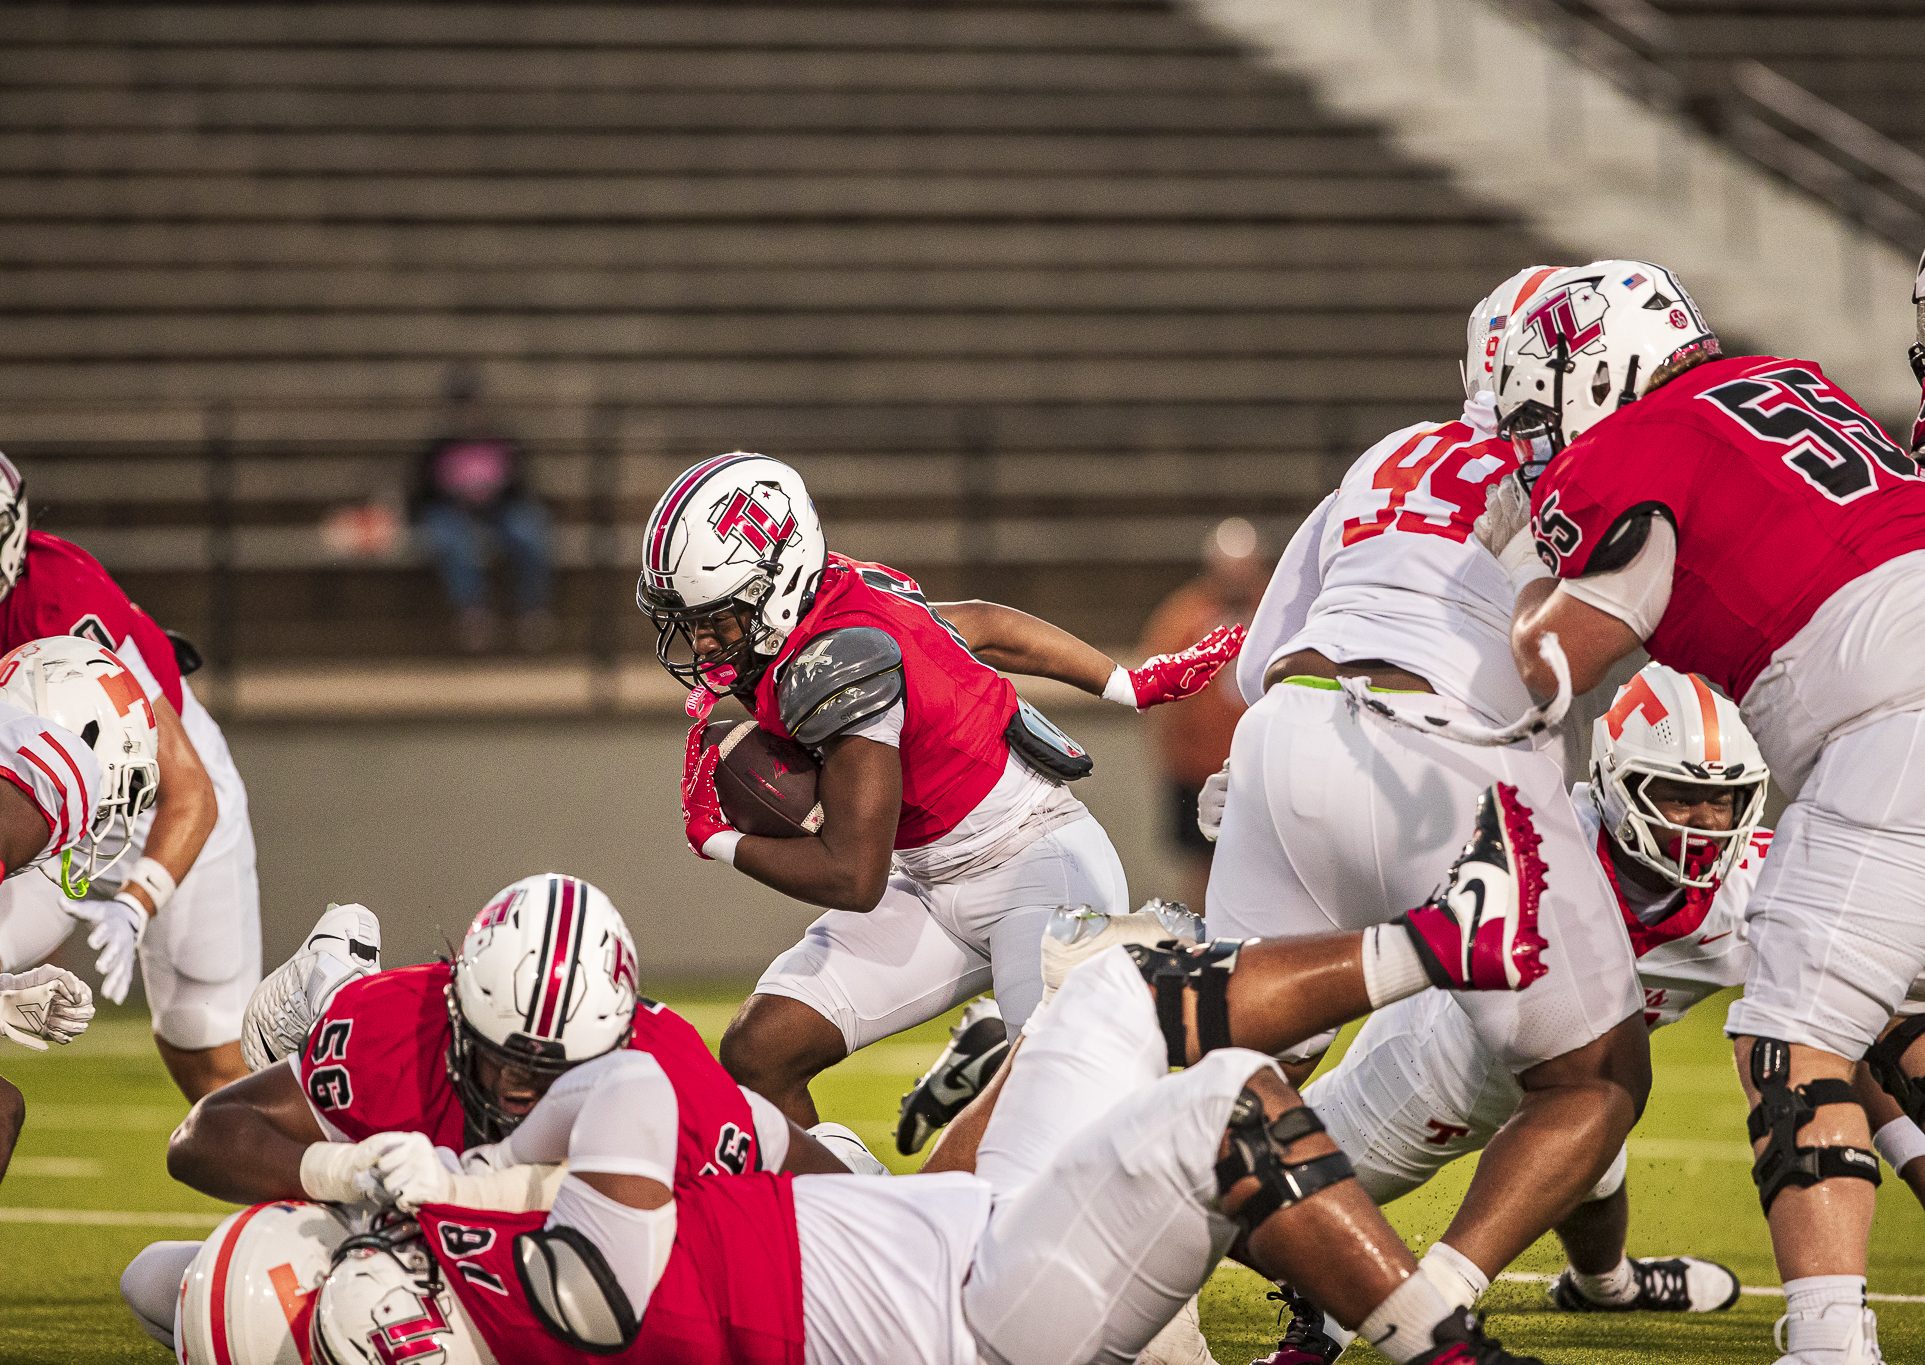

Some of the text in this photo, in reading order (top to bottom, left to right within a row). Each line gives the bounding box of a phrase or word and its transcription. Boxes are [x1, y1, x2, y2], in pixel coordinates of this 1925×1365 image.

[1523, 286, 1604, 357] TL
[1671, 311, 1687, 328] 55
[1693, 367, 1925, 506] 55
[1342, 421, 1521, 548] 99
[711, 487, 799, 556] TL
